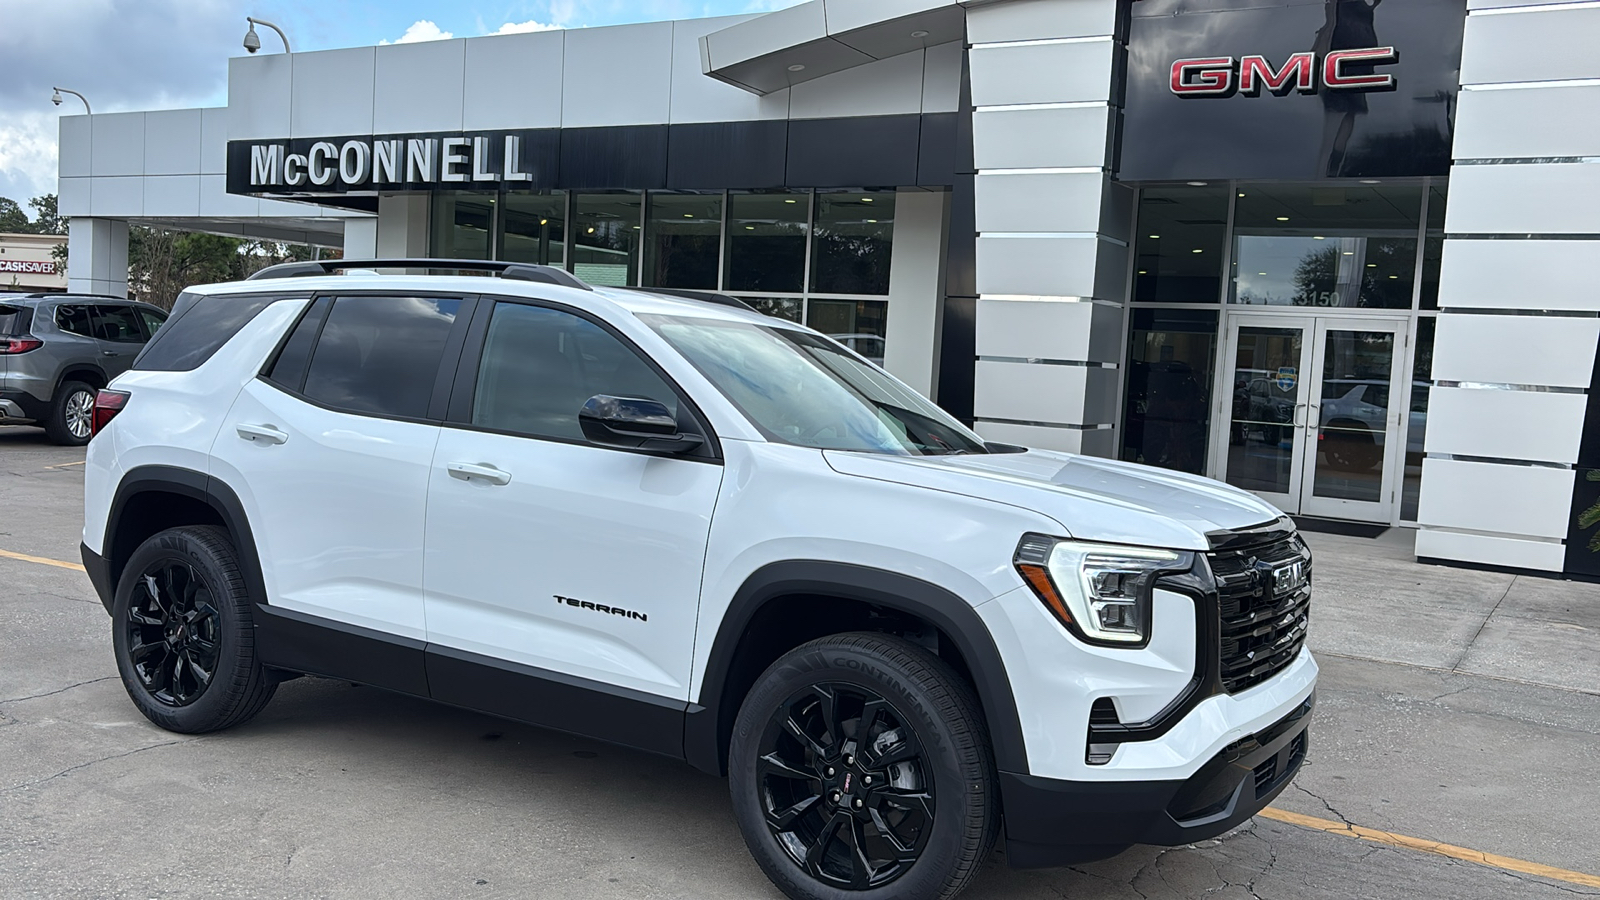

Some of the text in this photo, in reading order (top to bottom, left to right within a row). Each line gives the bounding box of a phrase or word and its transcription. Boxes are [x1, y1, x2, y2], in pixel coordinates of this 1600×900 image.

[1169, 46, 1397, 98] GMC
[1297, 290, 1340, 307] 3150
[553, 595, 647, 621] TERRAIN
[832, 656, 948, 754] CONTINENTAL
